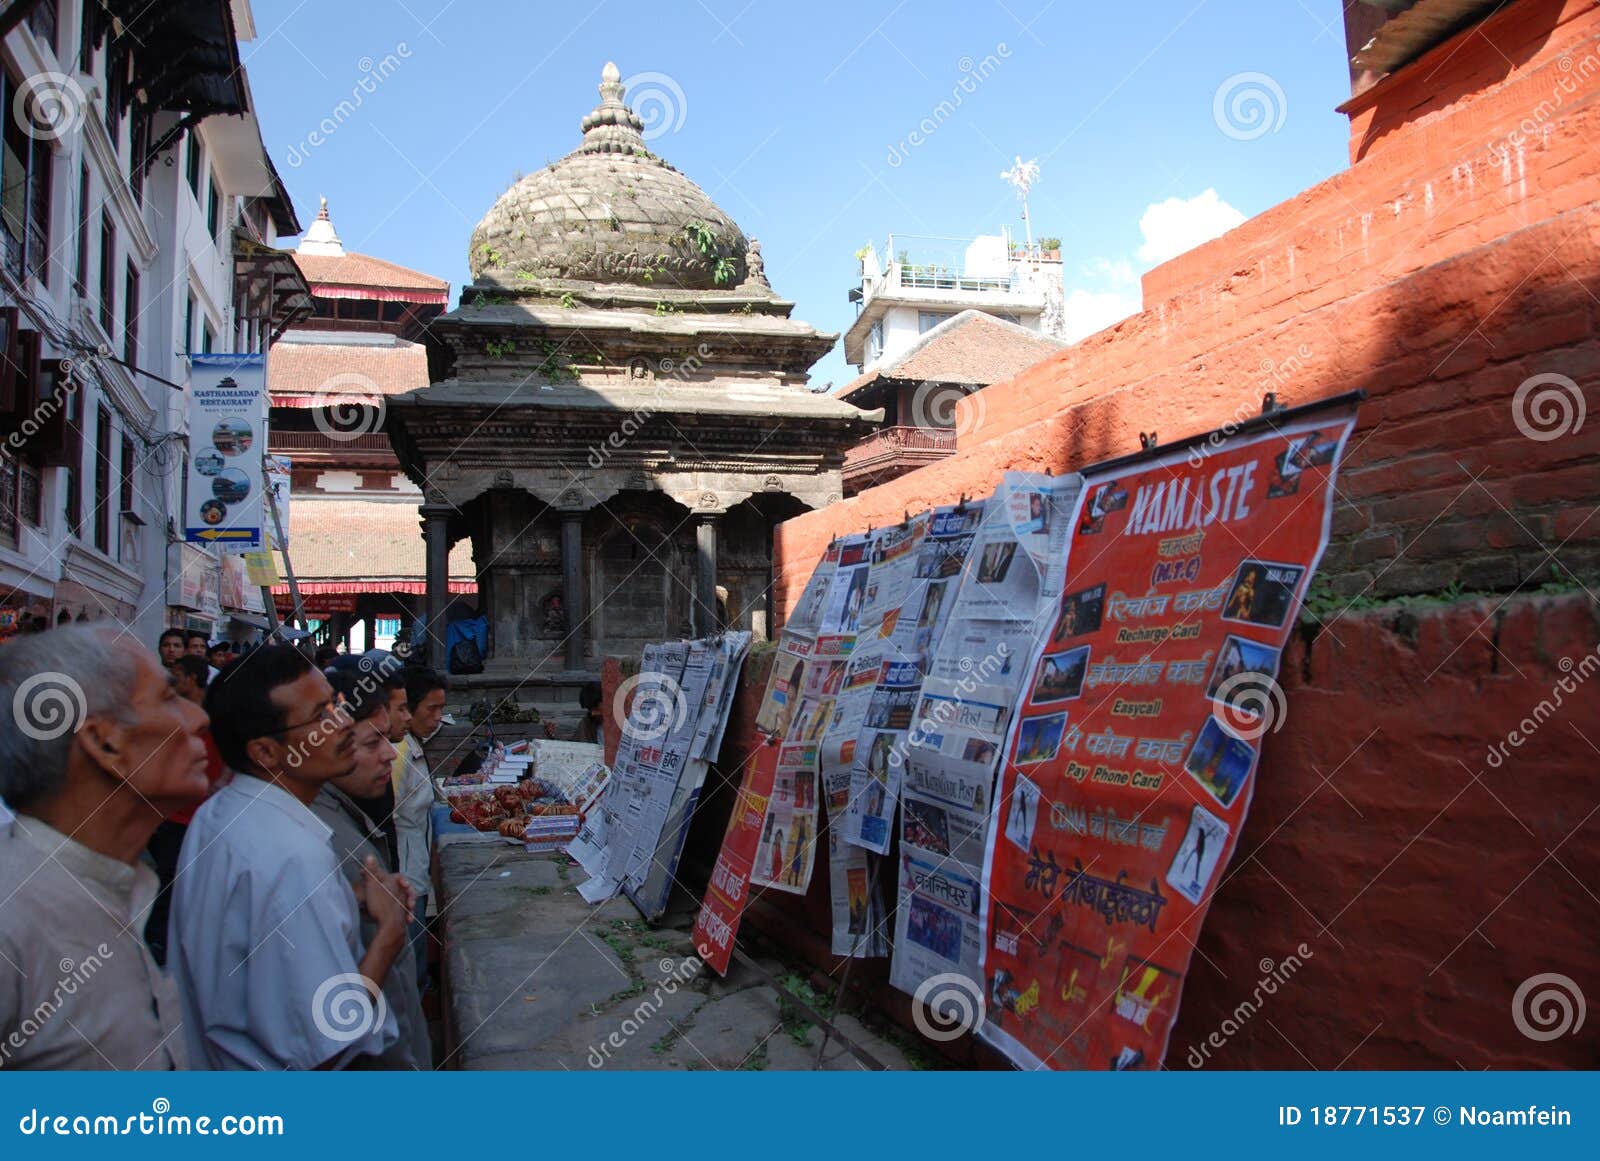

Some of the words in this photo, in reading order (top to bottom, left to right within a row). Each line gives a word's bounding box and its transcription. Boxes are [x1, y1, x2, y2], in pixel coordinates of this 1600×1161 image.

[1124, 460, 1259, 536] NAMASTE
[1173, 577, 1233, 611] कार्ड
[1117, 626, 1168, 643] Recharge
[1172, 622, 1201, 638] Card
[1112, 699, 1161, 718] Easycall
[1135, 730, 1193, 764] कार्ड
[1065, 762, 1088, 782] Pay
[1092, 767, 1129, 785] Phone
[1131, 770, 1163, 788] Card
[914, 871, 969, 908] कान्तिपुर
